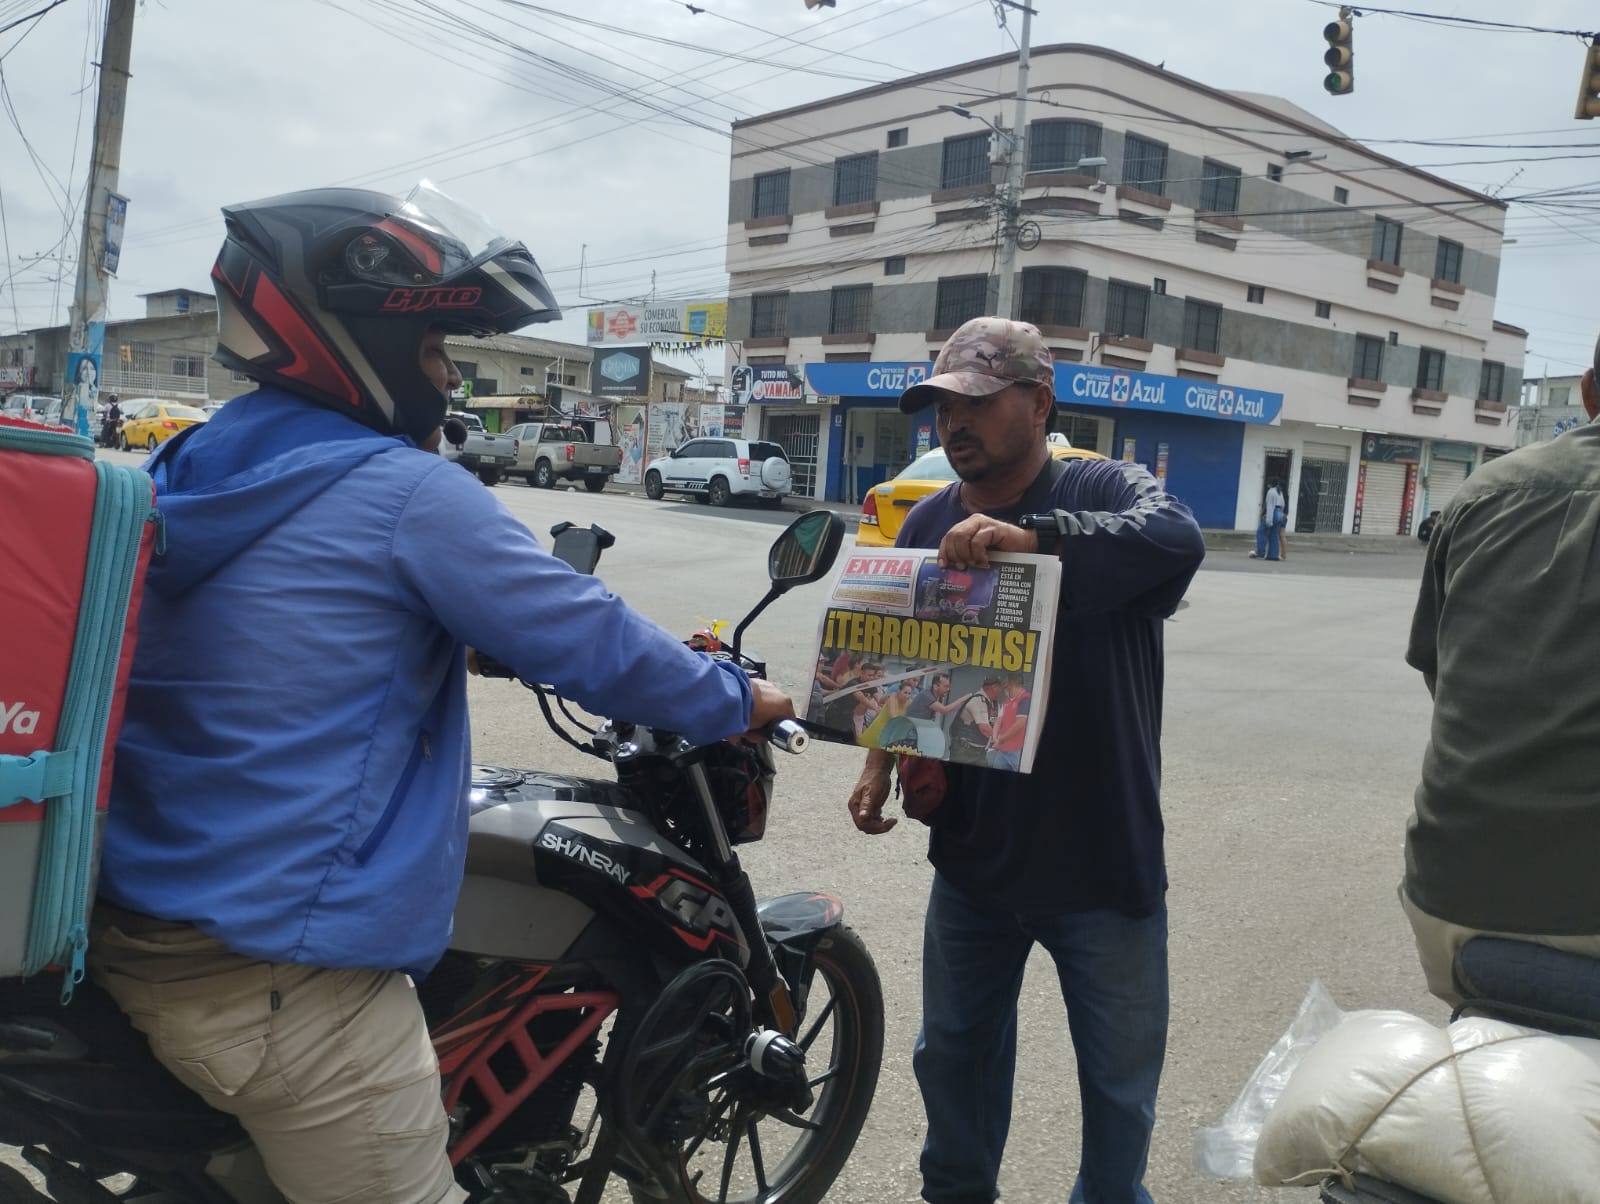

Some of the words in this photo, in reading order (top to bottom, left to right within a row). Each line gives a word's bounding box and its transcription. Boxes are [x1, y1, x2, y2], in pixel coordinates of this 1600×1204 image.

[644, 308, 678, 320] COMERCIAL
[640, 322, 649, 334] SU
[867, 368, 905, 390] Cruz
[1072, 372, 1111, 399] Cruz
[1131, 379, 1165, 404] Azul
[1185, 386, 1218, 411] Cruz
[1234, 394, 1264, 418] Azul
[845, 559, 914, 576] EXTRA
[1001, 566, 1025, 574] ECUADOR
[997, 593, 1028, 602] CRIMINALES
[1009, 588, 1030, 596] BANDAS
[1000, 615, 1024, 623] NUESTRO
[824, 610, 1037, 673] ¡TERRORISTAS!
[541, 833, 631, 884] SHINERAY
